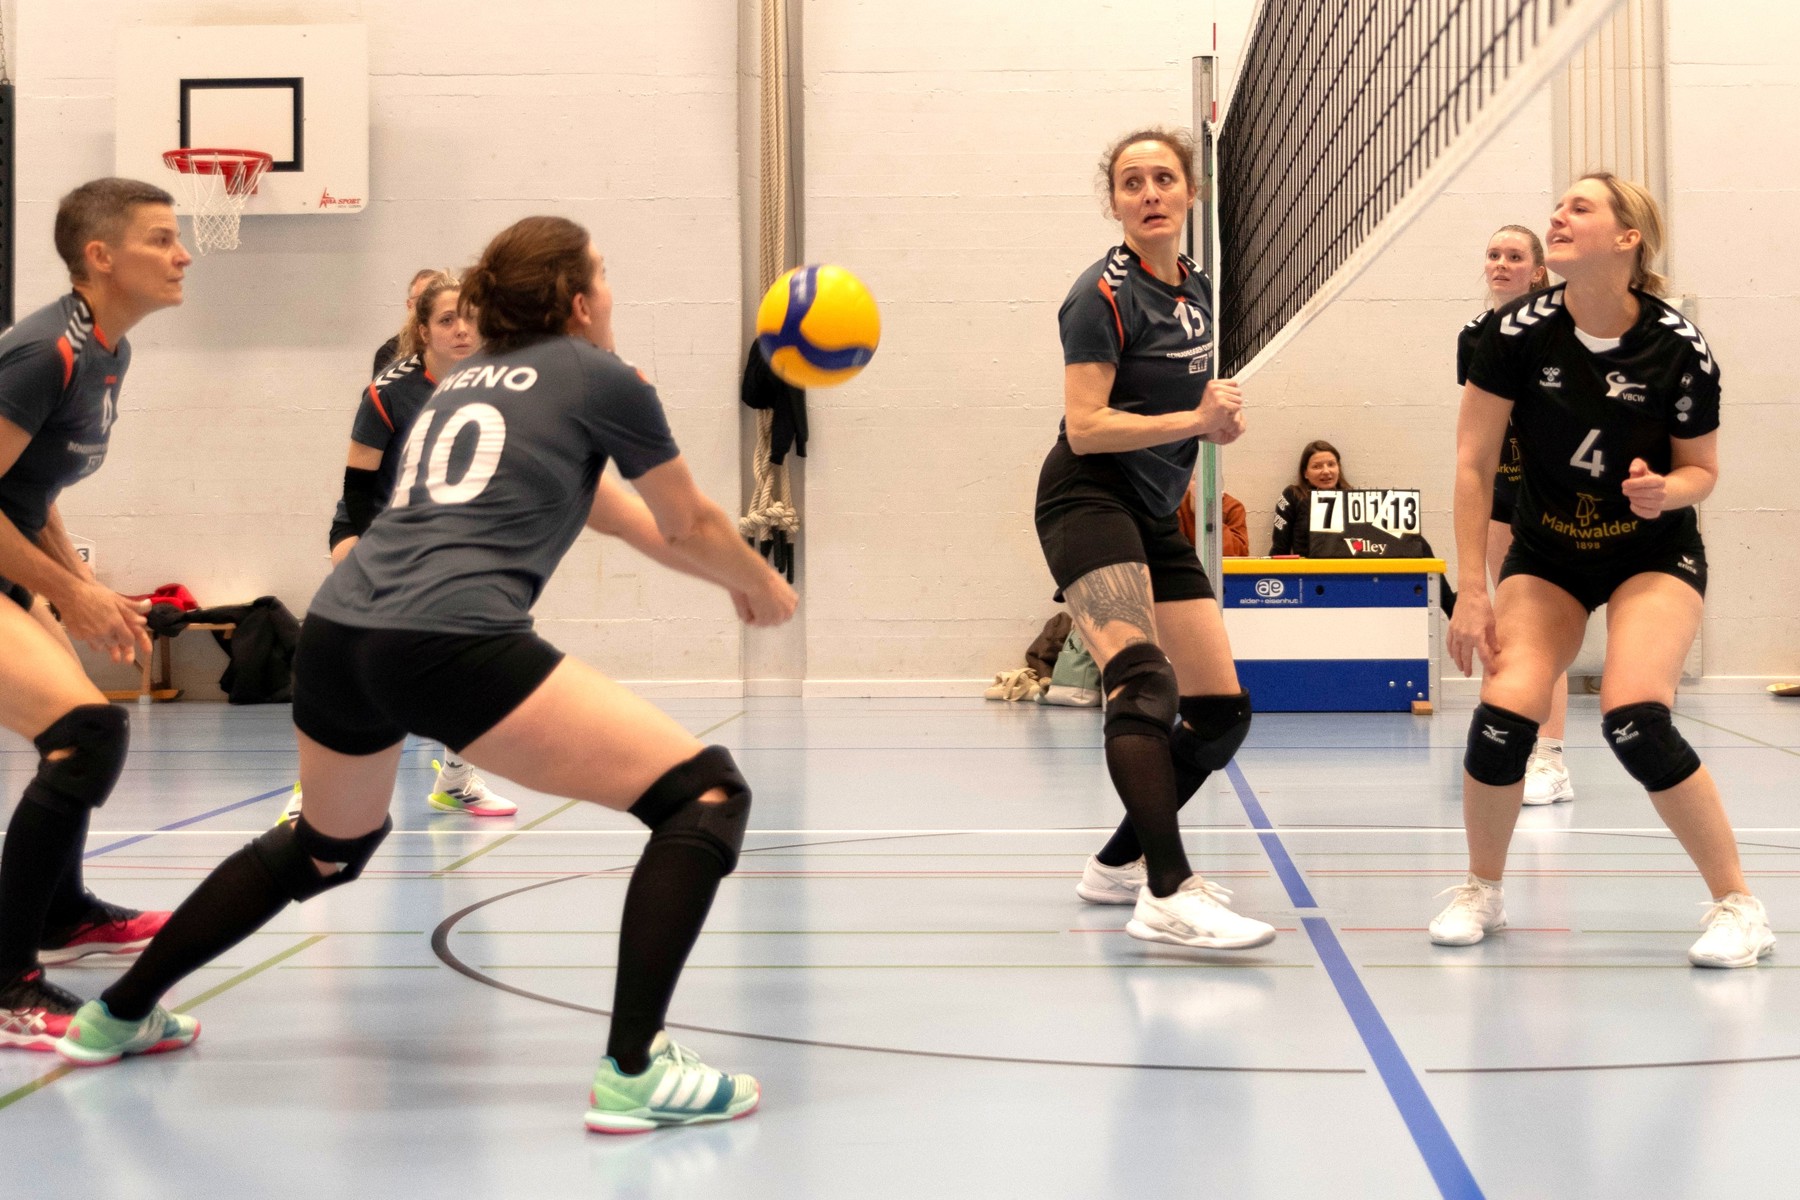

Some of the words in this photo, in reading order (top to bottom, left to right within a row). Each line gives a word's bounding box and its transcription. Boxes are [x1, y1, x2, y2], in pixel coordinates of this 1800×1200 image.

[1173, 301, 1205, 340] 15
[1539, 380, 1562, 388] hummel
[1622, 393, 1646, 402] VBCW
[391, 403, 506, 509] 10
[1570, 428, 1605, 478] 4
[1317, 496, 1337, 529] 7
[1390, 497, 1417, 531] 13
[1541, 512, 1639, 539] Markwalder
[1575, 541, 1601, 550] 1898
